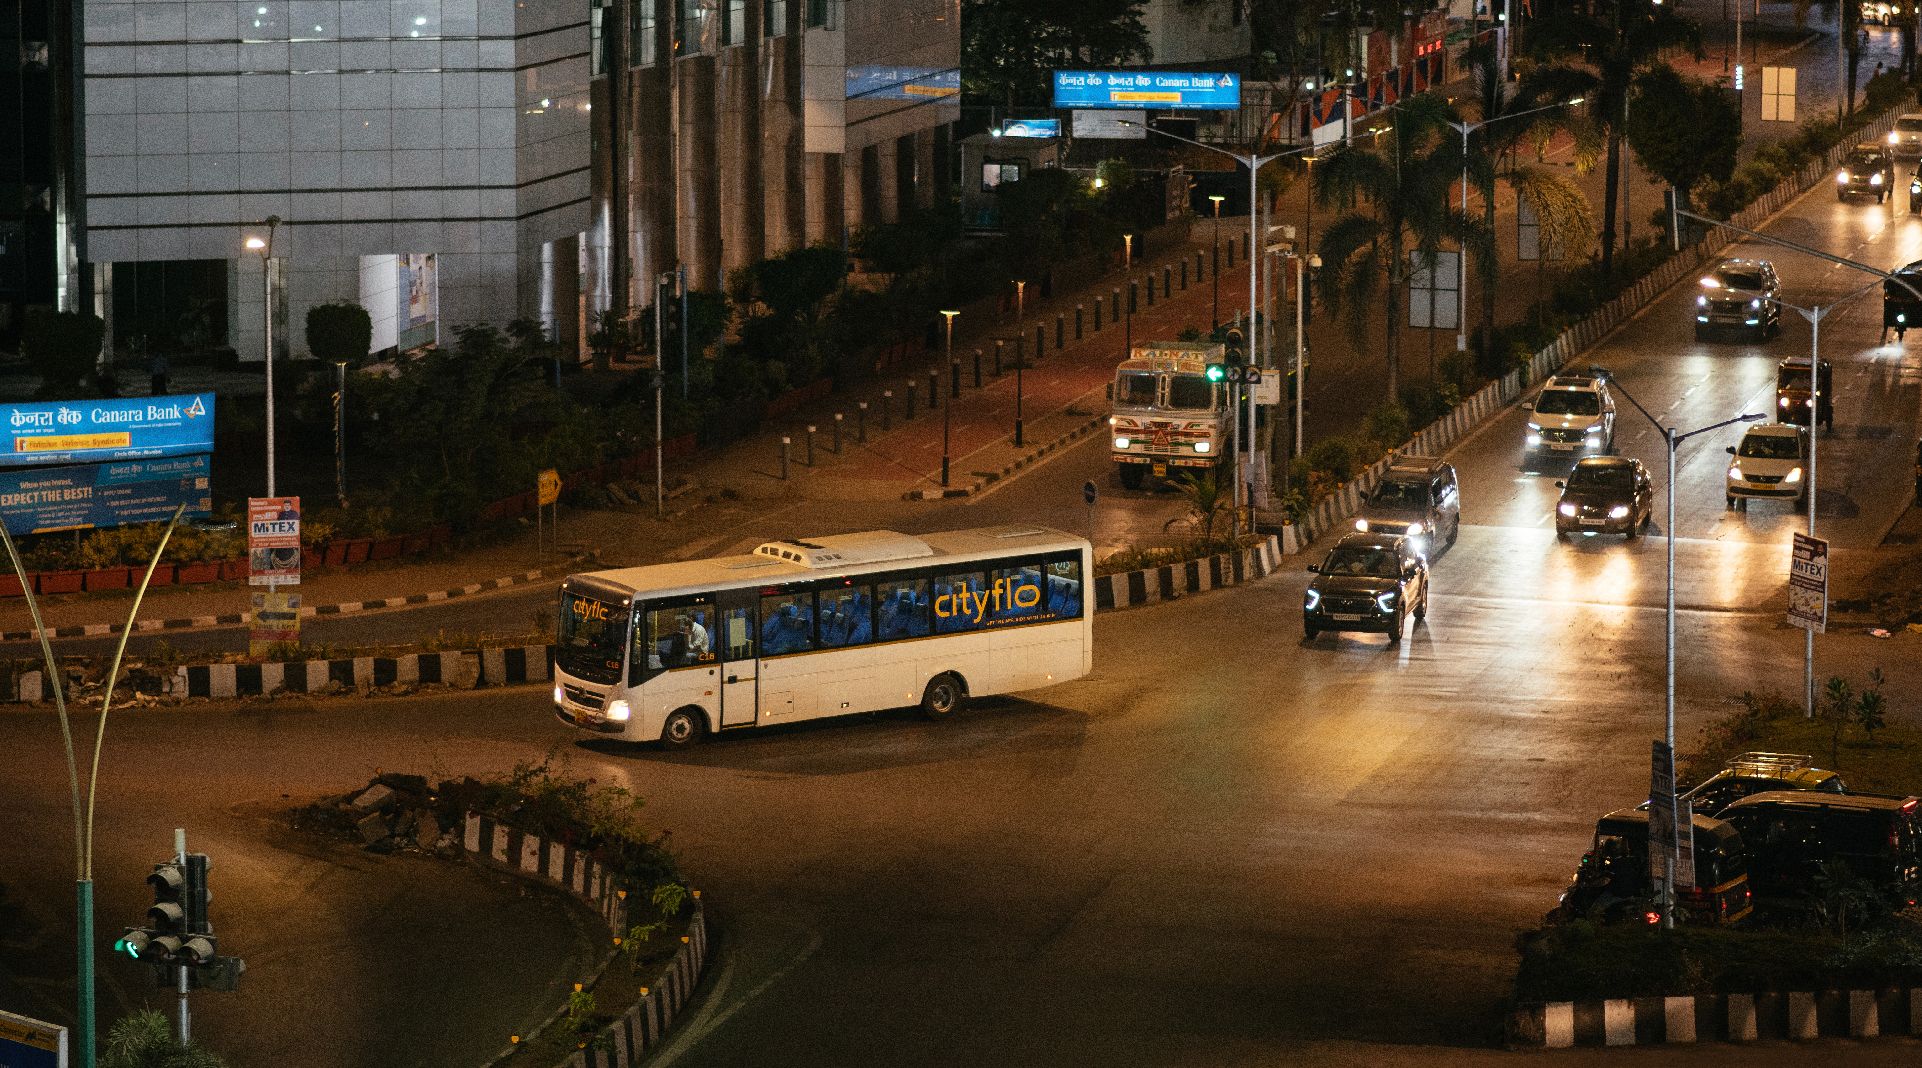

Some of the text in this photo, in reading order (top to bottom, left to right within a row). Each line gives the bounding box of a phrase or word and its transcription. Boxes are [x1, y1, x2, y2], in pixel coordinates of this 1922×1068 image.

[1156, 77, 1215, 88] Canara Bank
[10, 407, 82, 427] केनरा बैंक
[91, 404, 182, 424] Canara Bank
[1, 487, 93, 506] EXPECT THE BEST!
[934, 577, 1041, 624] cityflo
